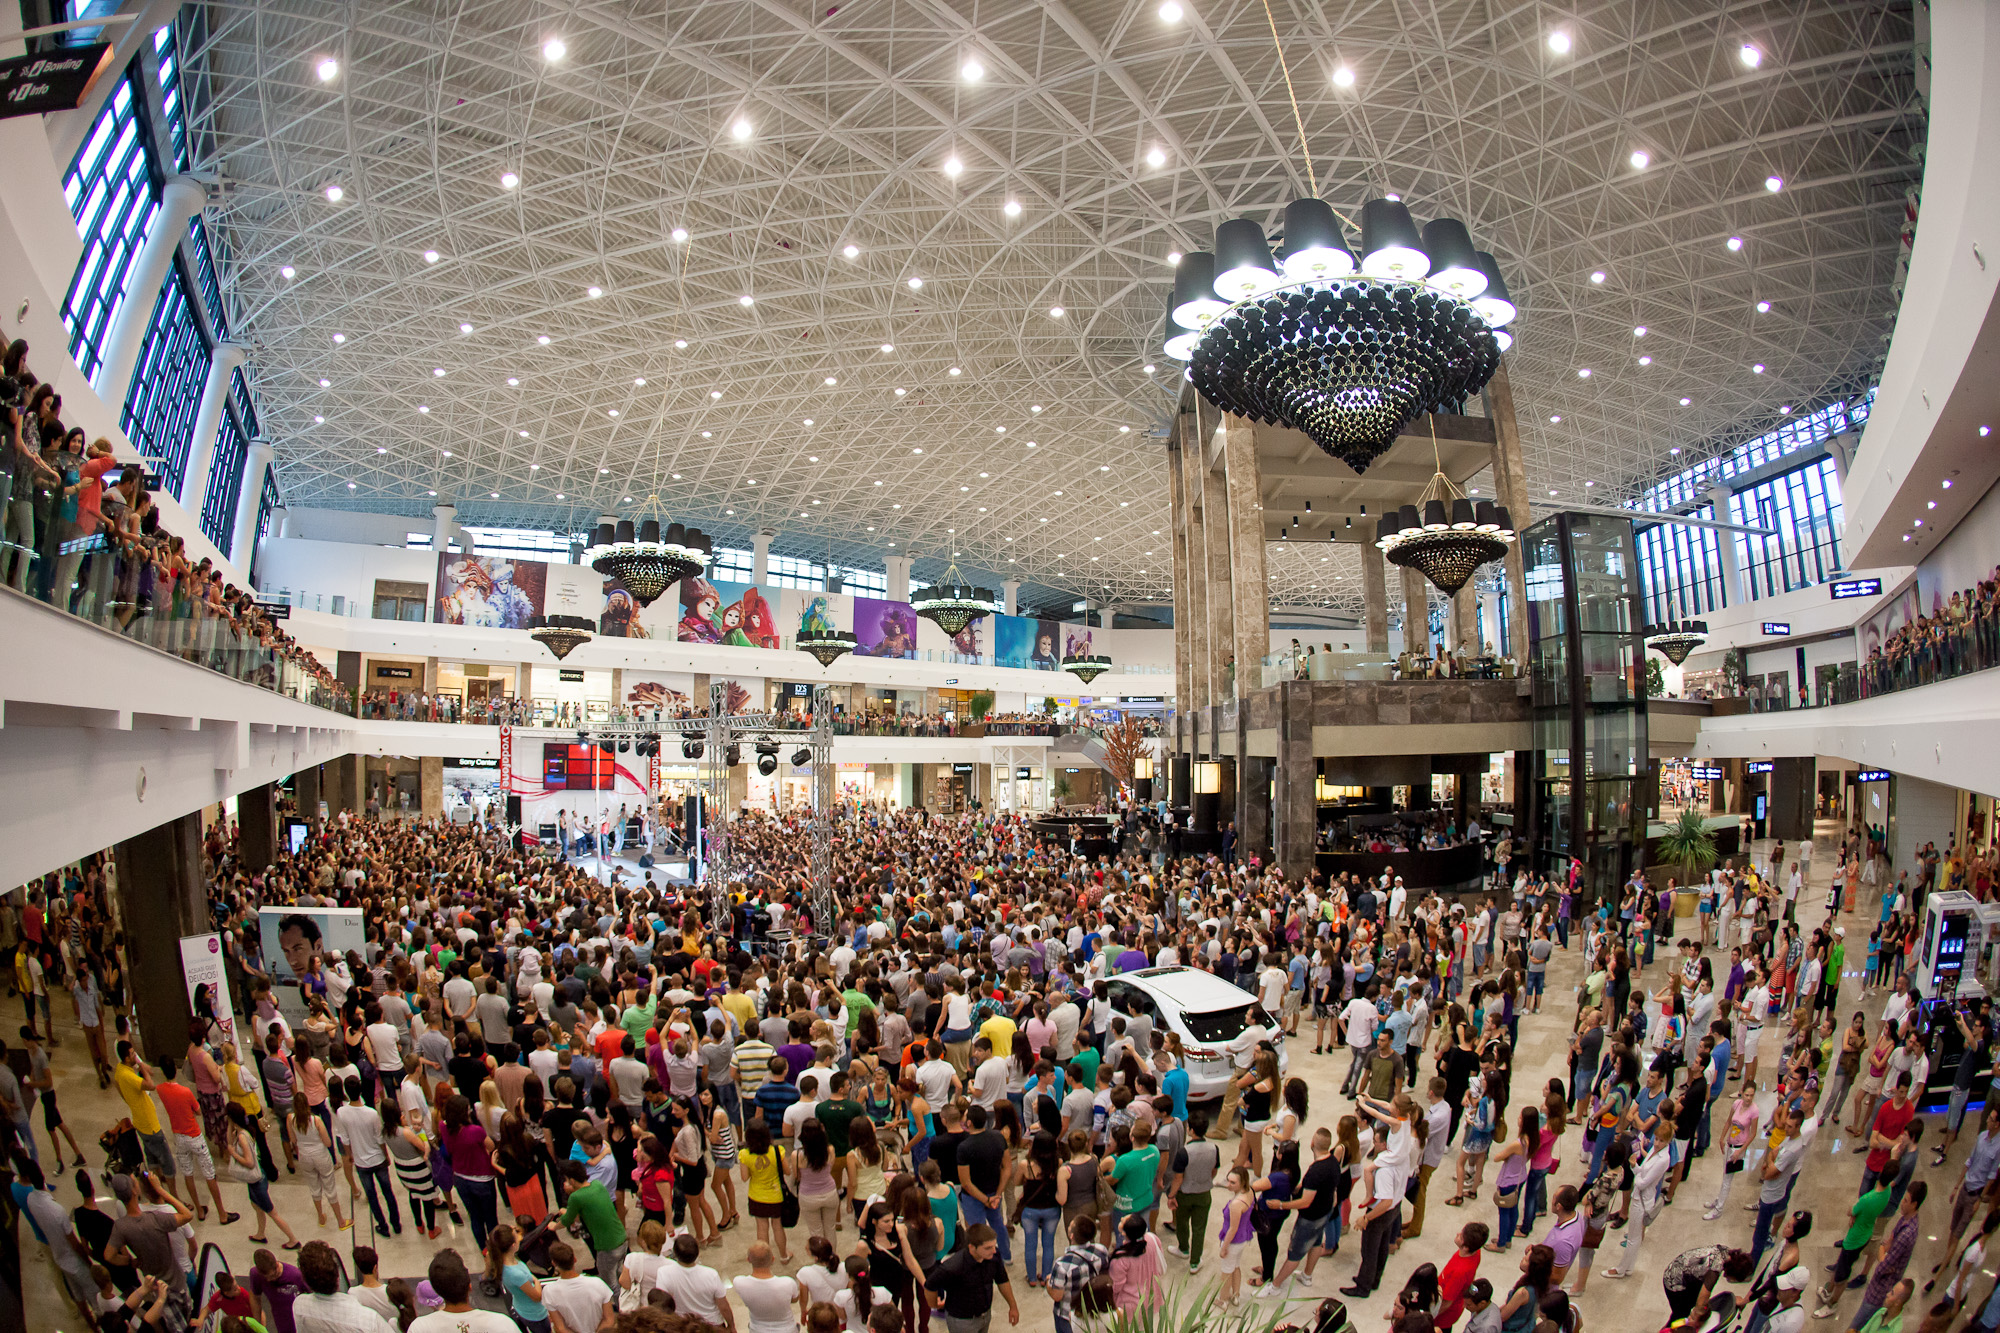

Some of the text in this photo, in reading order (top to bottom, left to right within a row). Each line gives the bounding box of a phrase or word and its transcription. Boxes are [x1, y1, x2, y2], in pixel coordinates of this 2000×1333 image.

[43, 59, 84, 72] Bowling
[29, 84, 50, 96] Info
[502, 737, 511, 787] vodafone
